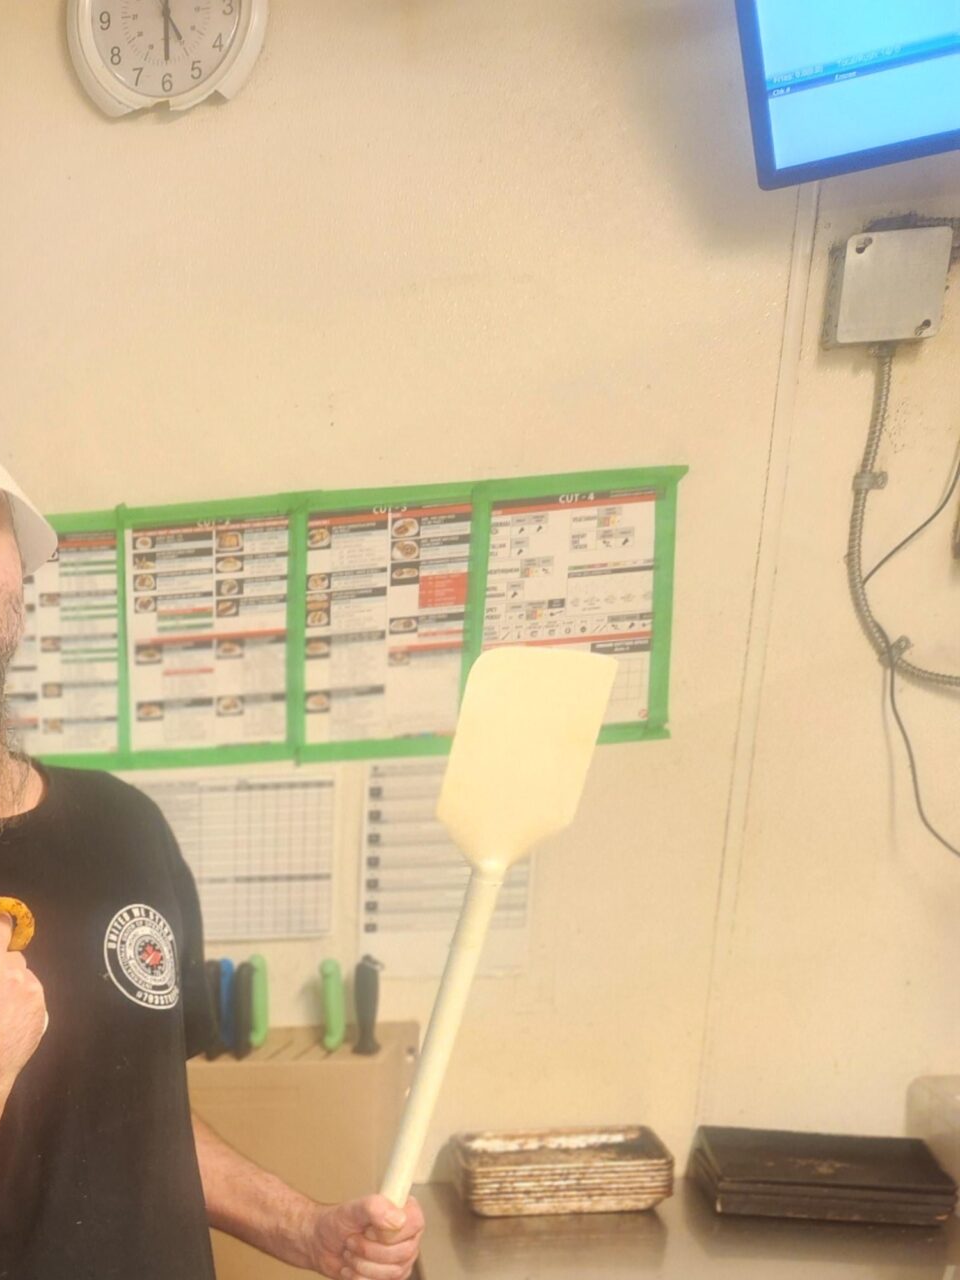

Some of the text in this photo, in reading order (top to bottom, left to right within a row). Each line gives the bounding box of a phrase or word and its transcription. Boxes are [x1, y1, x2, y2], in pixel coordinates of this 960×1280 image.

[221, 0, 234, 17] 3
[99, 10, 111, 32] 9
[211, 33, 225, 52] 4
[110, 46, 122, 66] 8
[132, 67, 144, 87] 7
[190, 60, 203, 80] 5
[161, 72, 174, 92] 6
